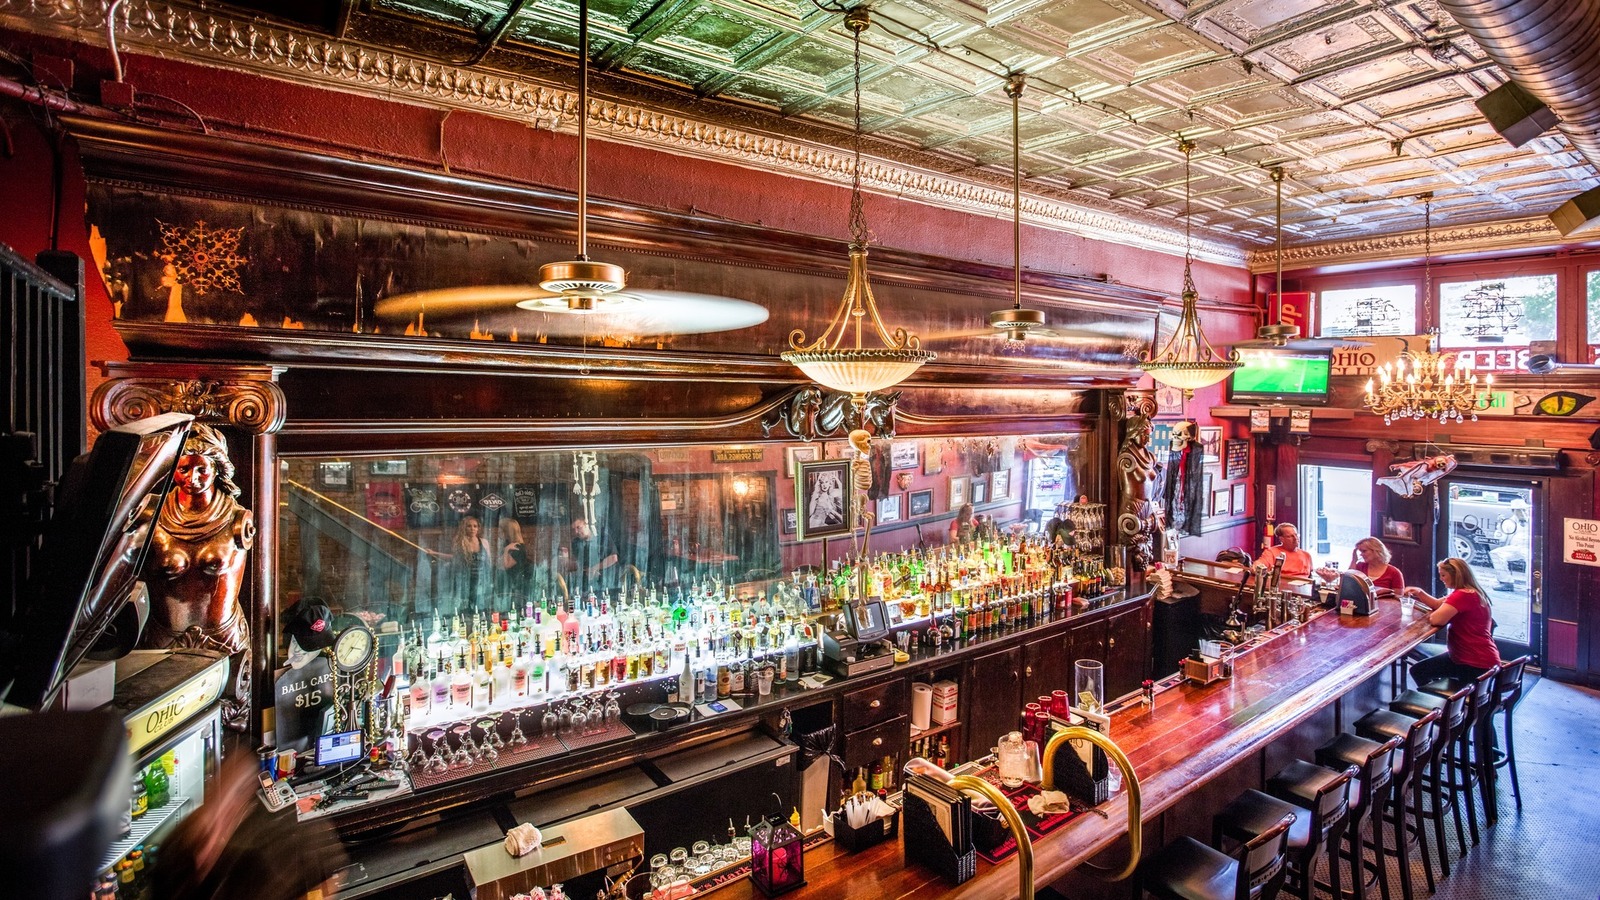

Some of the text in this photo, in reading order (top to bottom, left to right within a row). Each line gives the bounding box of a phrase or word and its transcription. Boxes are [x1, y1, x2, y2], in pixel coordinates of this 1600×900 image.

[1572, 522, 1598, 532] OHIO
[281, 673, 334, 695] BALL CAPS
[294, 689, 322, 708] $15
[713, 866, 752, 885] Mark
